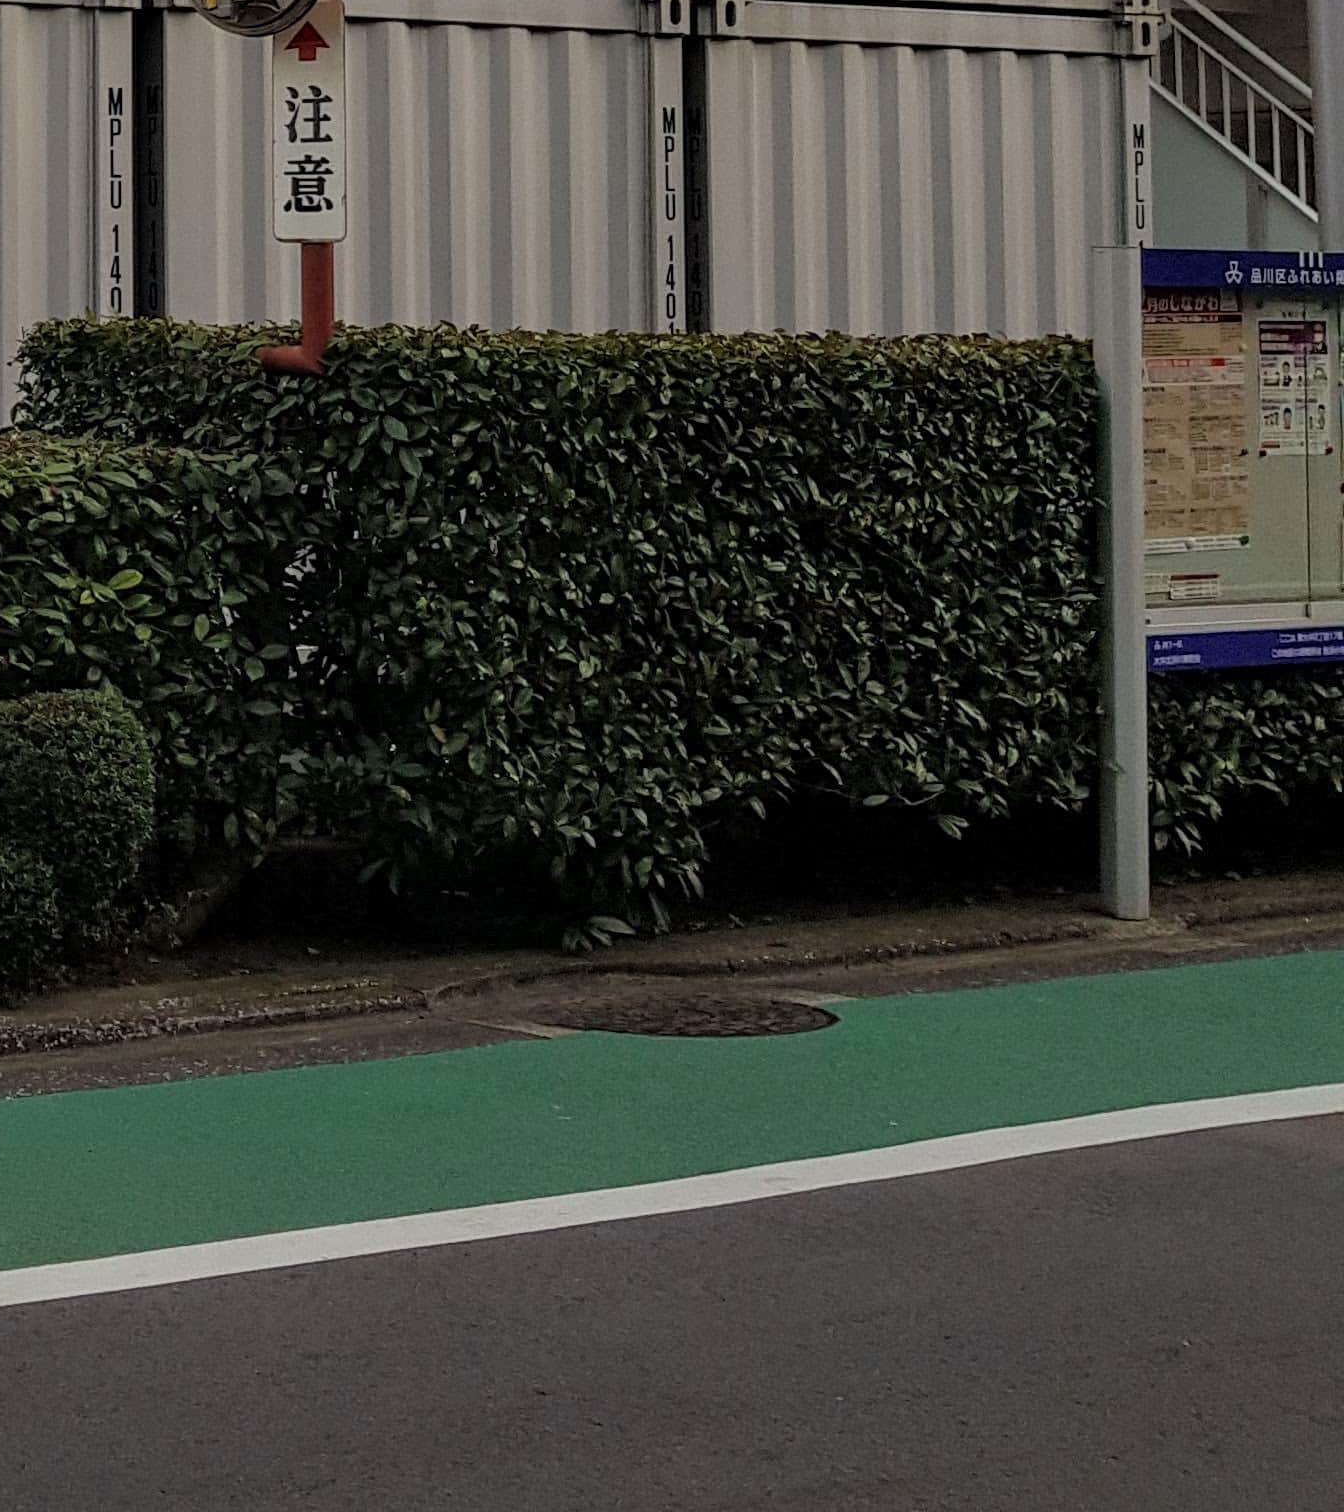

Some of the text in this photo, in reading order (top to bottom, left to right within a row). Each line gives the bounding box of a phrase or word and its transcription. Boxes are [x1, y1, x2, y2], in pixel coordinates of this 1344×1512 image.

[108, 87, 123, 209] MPLU
[283, 85, 335, 214] 注意
[663, 107, 675, 221] MPLU
[1133, 124, 1145, 230] MPLU
